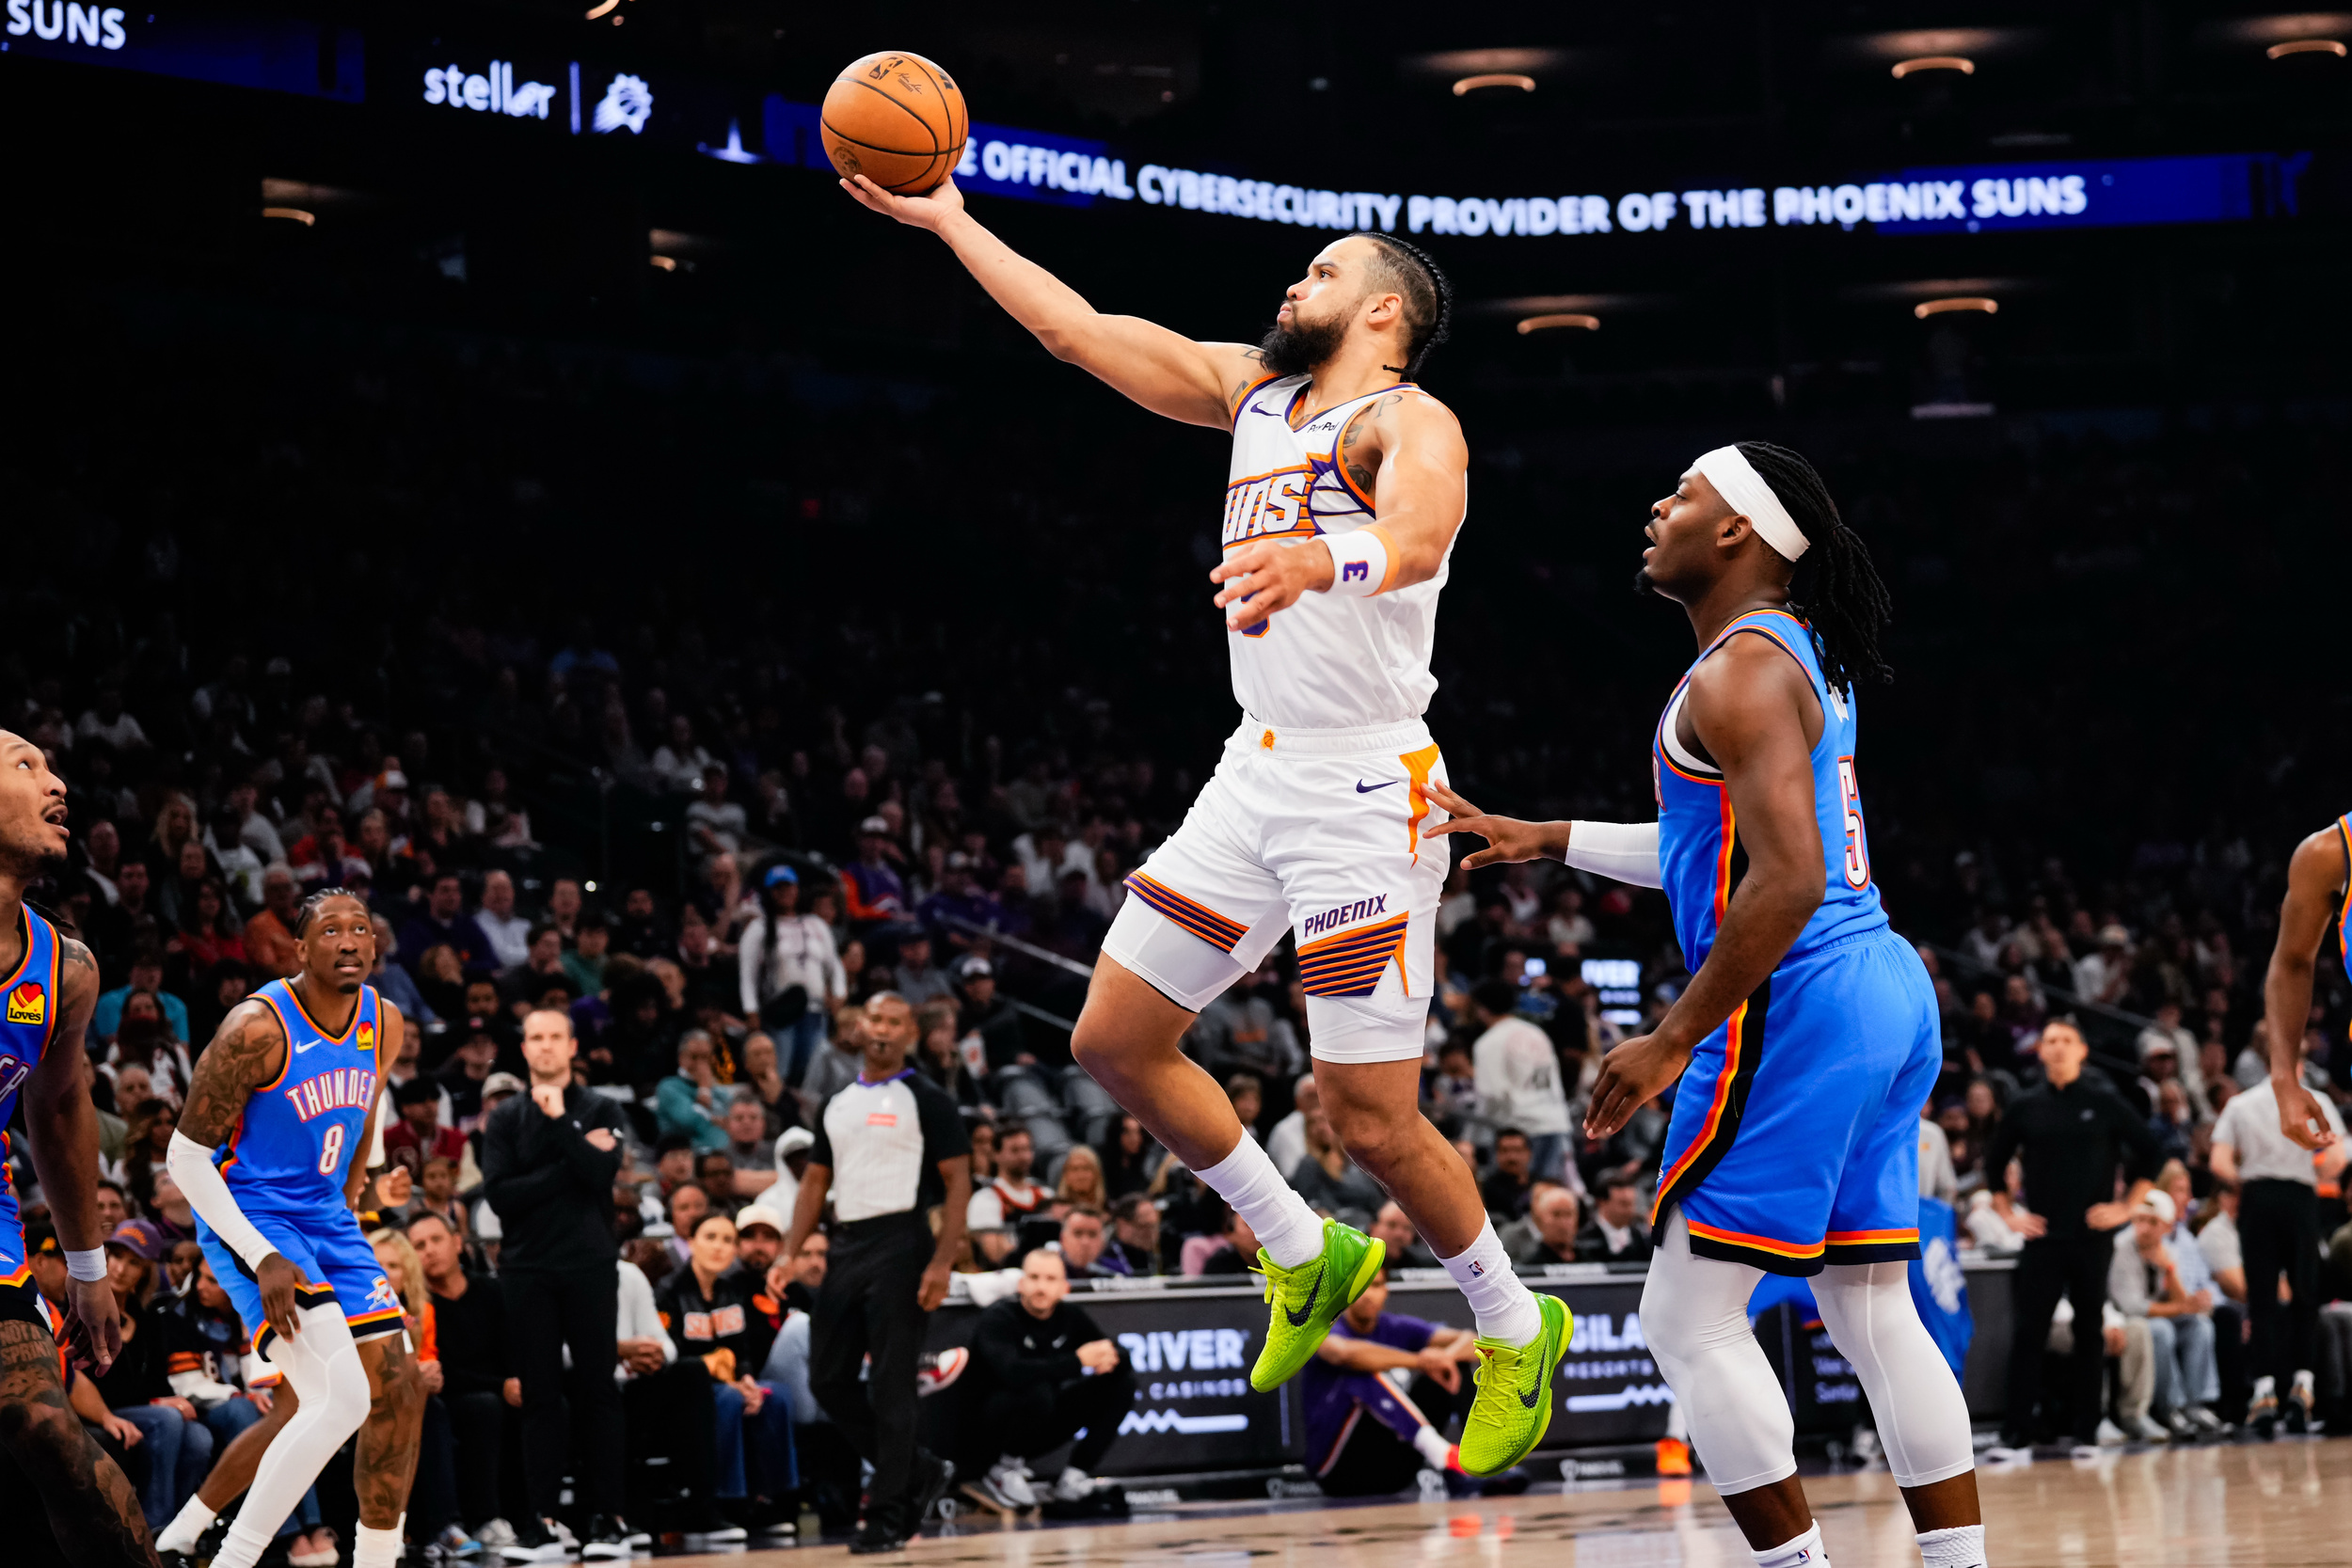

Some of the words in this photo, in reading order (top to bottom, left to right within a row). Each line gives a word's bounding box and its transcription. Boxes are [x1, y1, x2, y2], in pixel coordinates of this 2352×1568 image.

[7, 0, 126, 50] SUNS
[982, 140, 1135, 200] OFFICIAL
[1136, 164, 1403, 231] CYBERSECURITY
[1407, 195, 1612, 237] PROVIDER
[1616, 193, 1677, 232] OF
[1681, 189, 1767, 229] THE
[1773, 180, 1966, 226] PHOENIX
[1971, 175, 2089, 218] SUNS
[1343, 560, 1369, 582] 3
[1837, 755, 1870, 891] 5
[1304, 893, 1388, 939] PHOENIX
[284, 1067, 377, 1123] THUNDER
[318, 1123, 345, 1177] 8
[1117, 1327, 1247, 1373] RIVER
[1568, 1311, 1648, 1354] GILA
[1149, 1378, 1248, 1401] CASINOS
